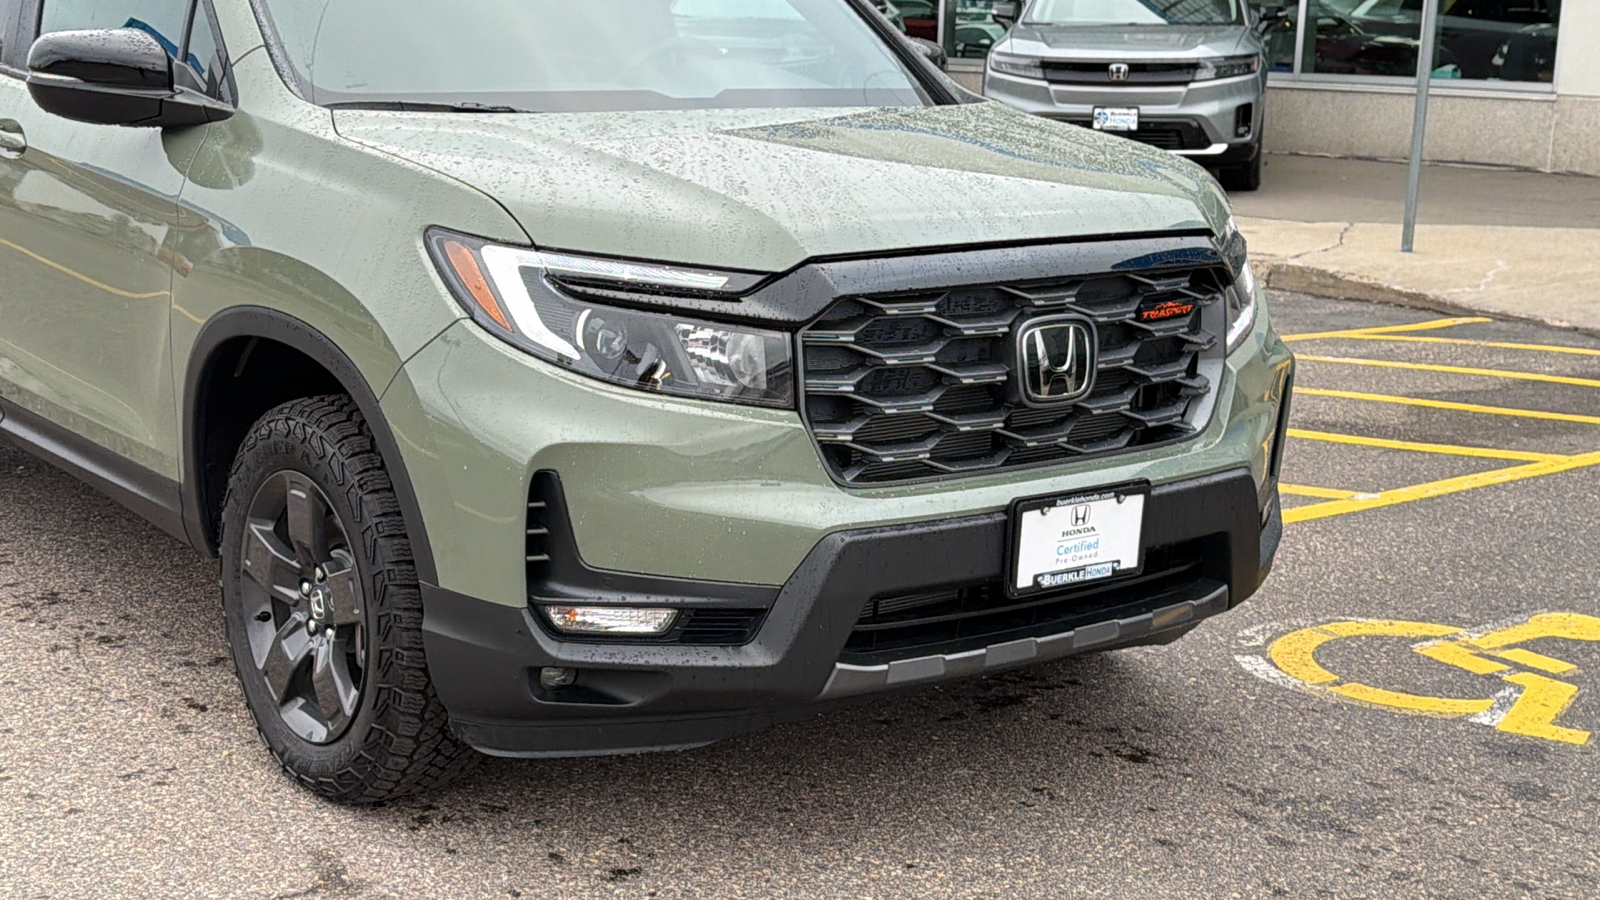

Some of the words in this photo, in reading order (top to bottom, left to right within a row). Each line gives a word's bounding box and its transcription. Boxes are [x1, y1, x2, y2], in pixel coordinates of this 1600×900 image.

[1056, 492, 1115, 506] buerklehonda.com
[1061, 526, 1097, 538] HONDA
[1056, 538, 1100, 557] Certified
[1055, 551, 1099, 565] Pre-Owned
[1044, 569, 1085, 586] BUERKLE
[1086, 566, 1111, 578] HONDA
